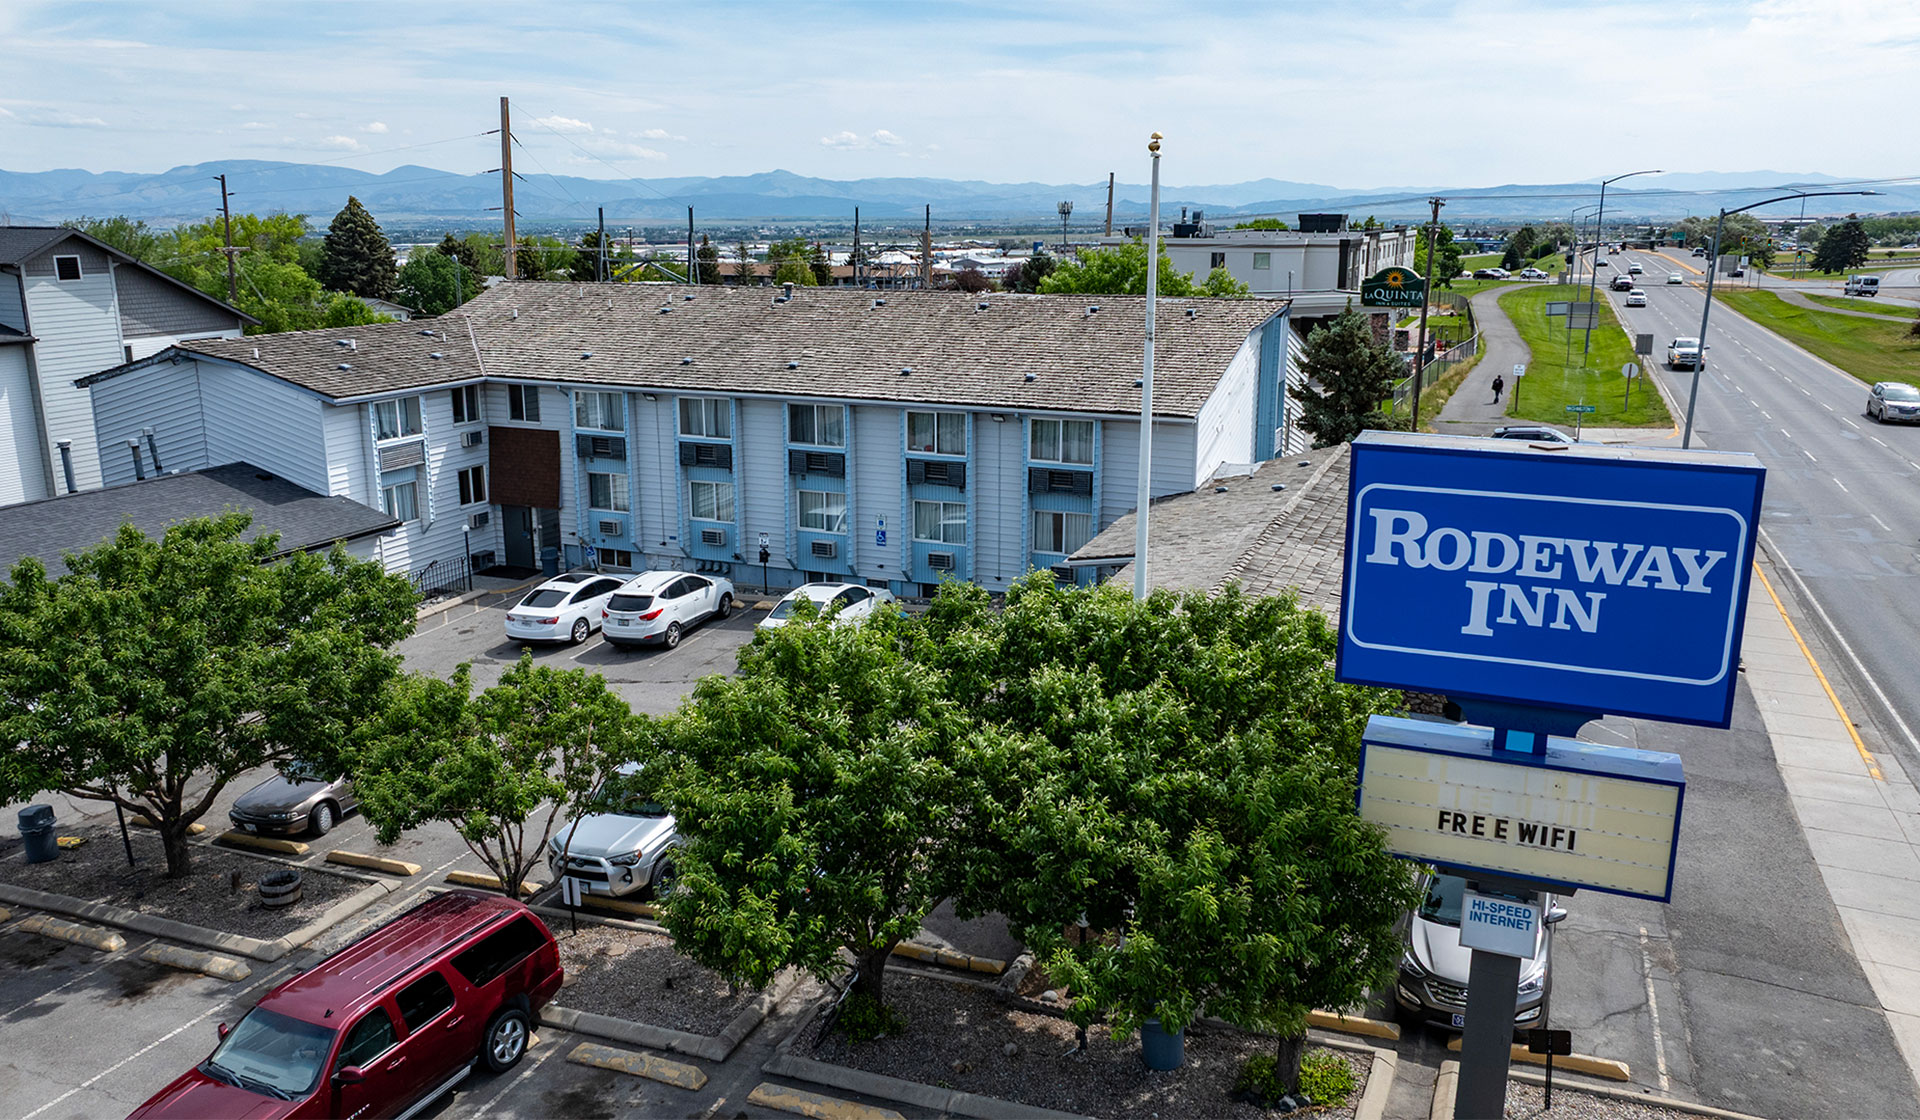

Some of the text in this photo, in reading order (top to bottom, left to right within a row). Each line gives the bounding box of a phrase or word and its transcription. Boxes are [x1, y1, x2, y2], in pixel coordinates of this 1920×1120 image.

[1366, 508, 1727, 594] RODEWAY
[1461, 580, 1607, 637] INN
[1518, 822, 1576, 851] WIFI
[1469, 910, 1533, 931] INTERNET
[1472, 899, 1532, 920] HI-SPEED
